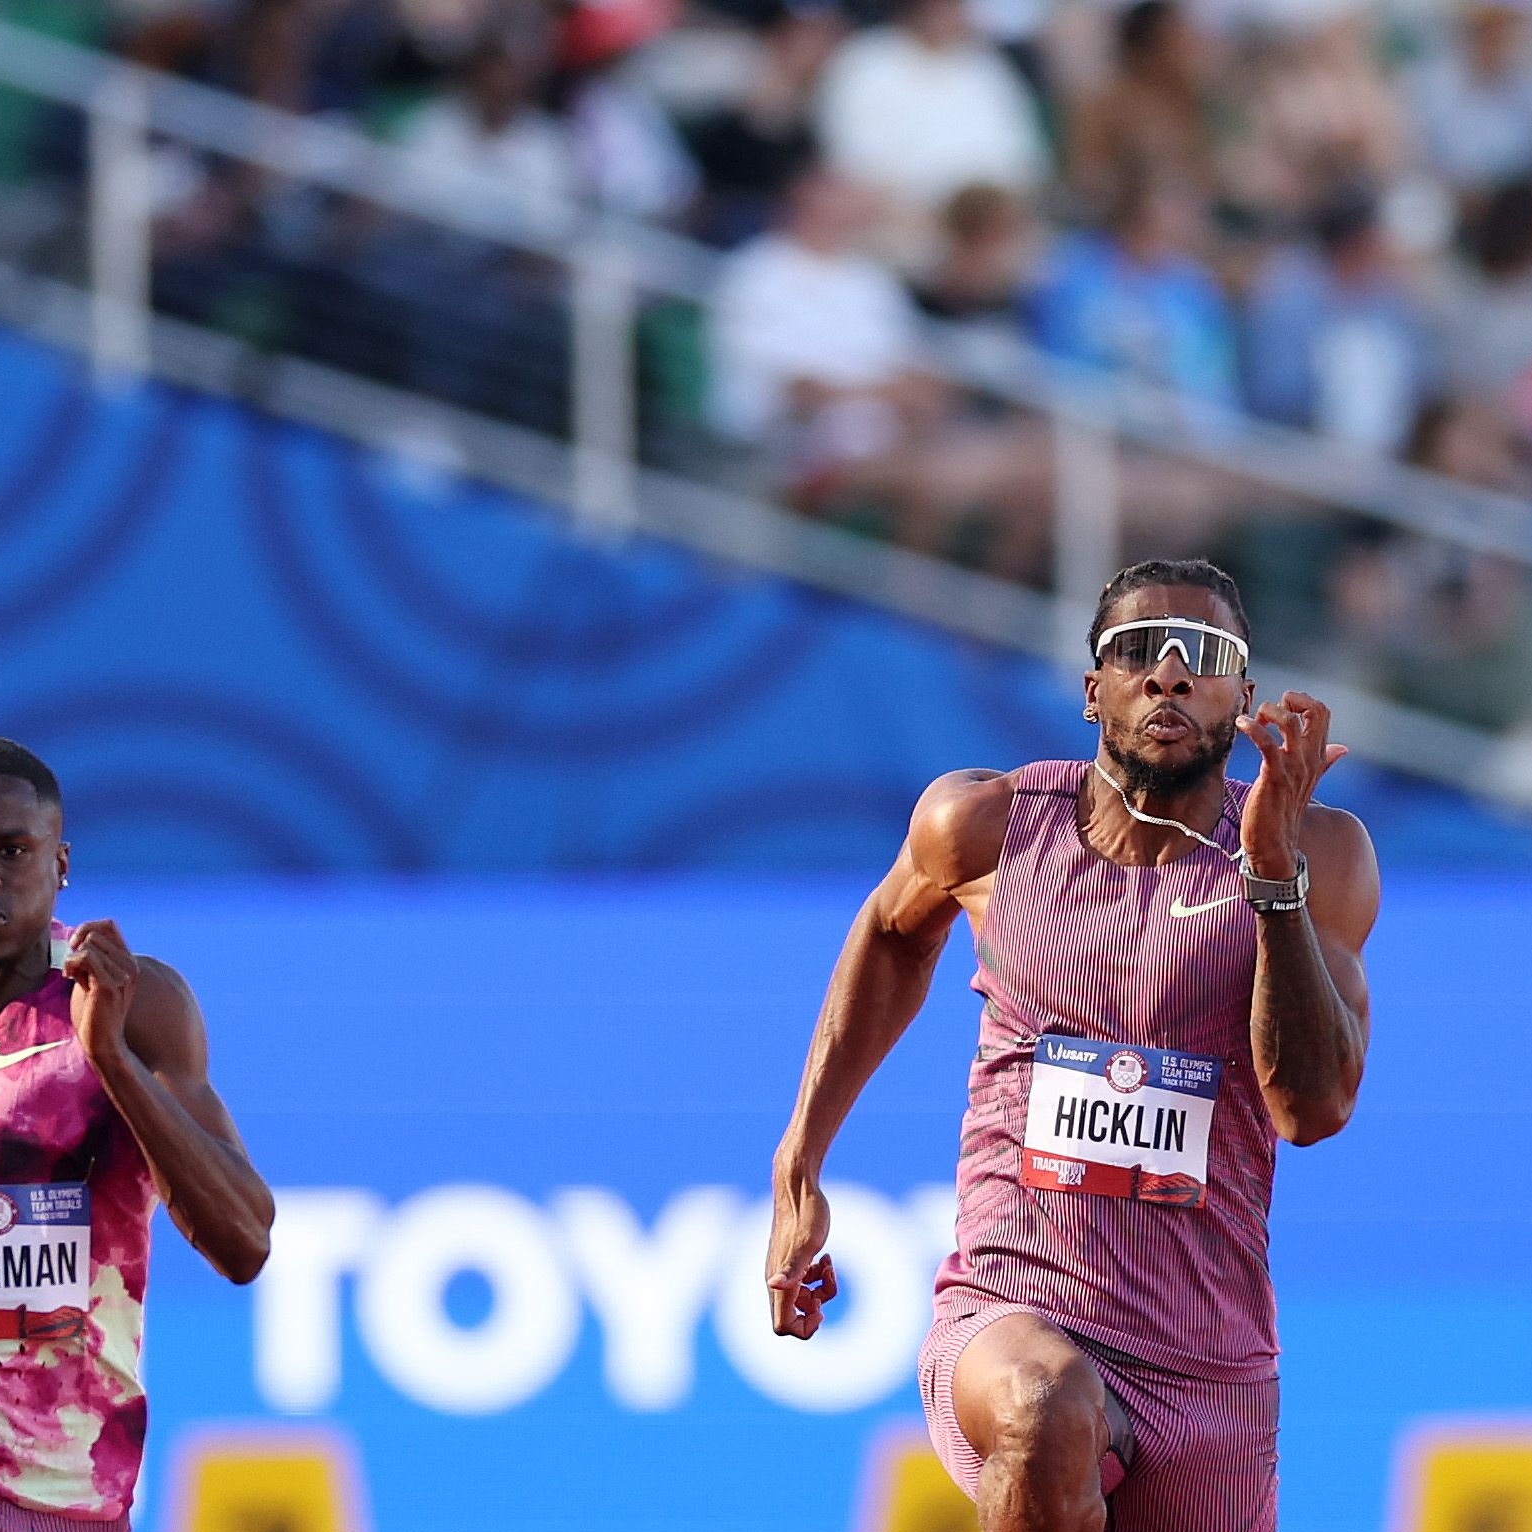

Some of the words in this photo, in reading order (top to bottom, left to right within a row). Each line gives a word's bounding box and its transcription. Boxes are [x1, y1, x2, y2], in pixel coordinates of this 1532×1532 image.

[1062, 1050, 1098, 1063] USATF
[1180, 1058, 1213, 1071] OLYMPIC
[1161, 1066, 1182, 1078] TEAM
[1184, 1070, 1212, 1083] TRIALS
[1054, 1096, 1187, 1153] HICKLIN
[1031, 1156, 1086, 1174] TRACKTOWN
[1057, 1172, 1082, 1186] 2024
